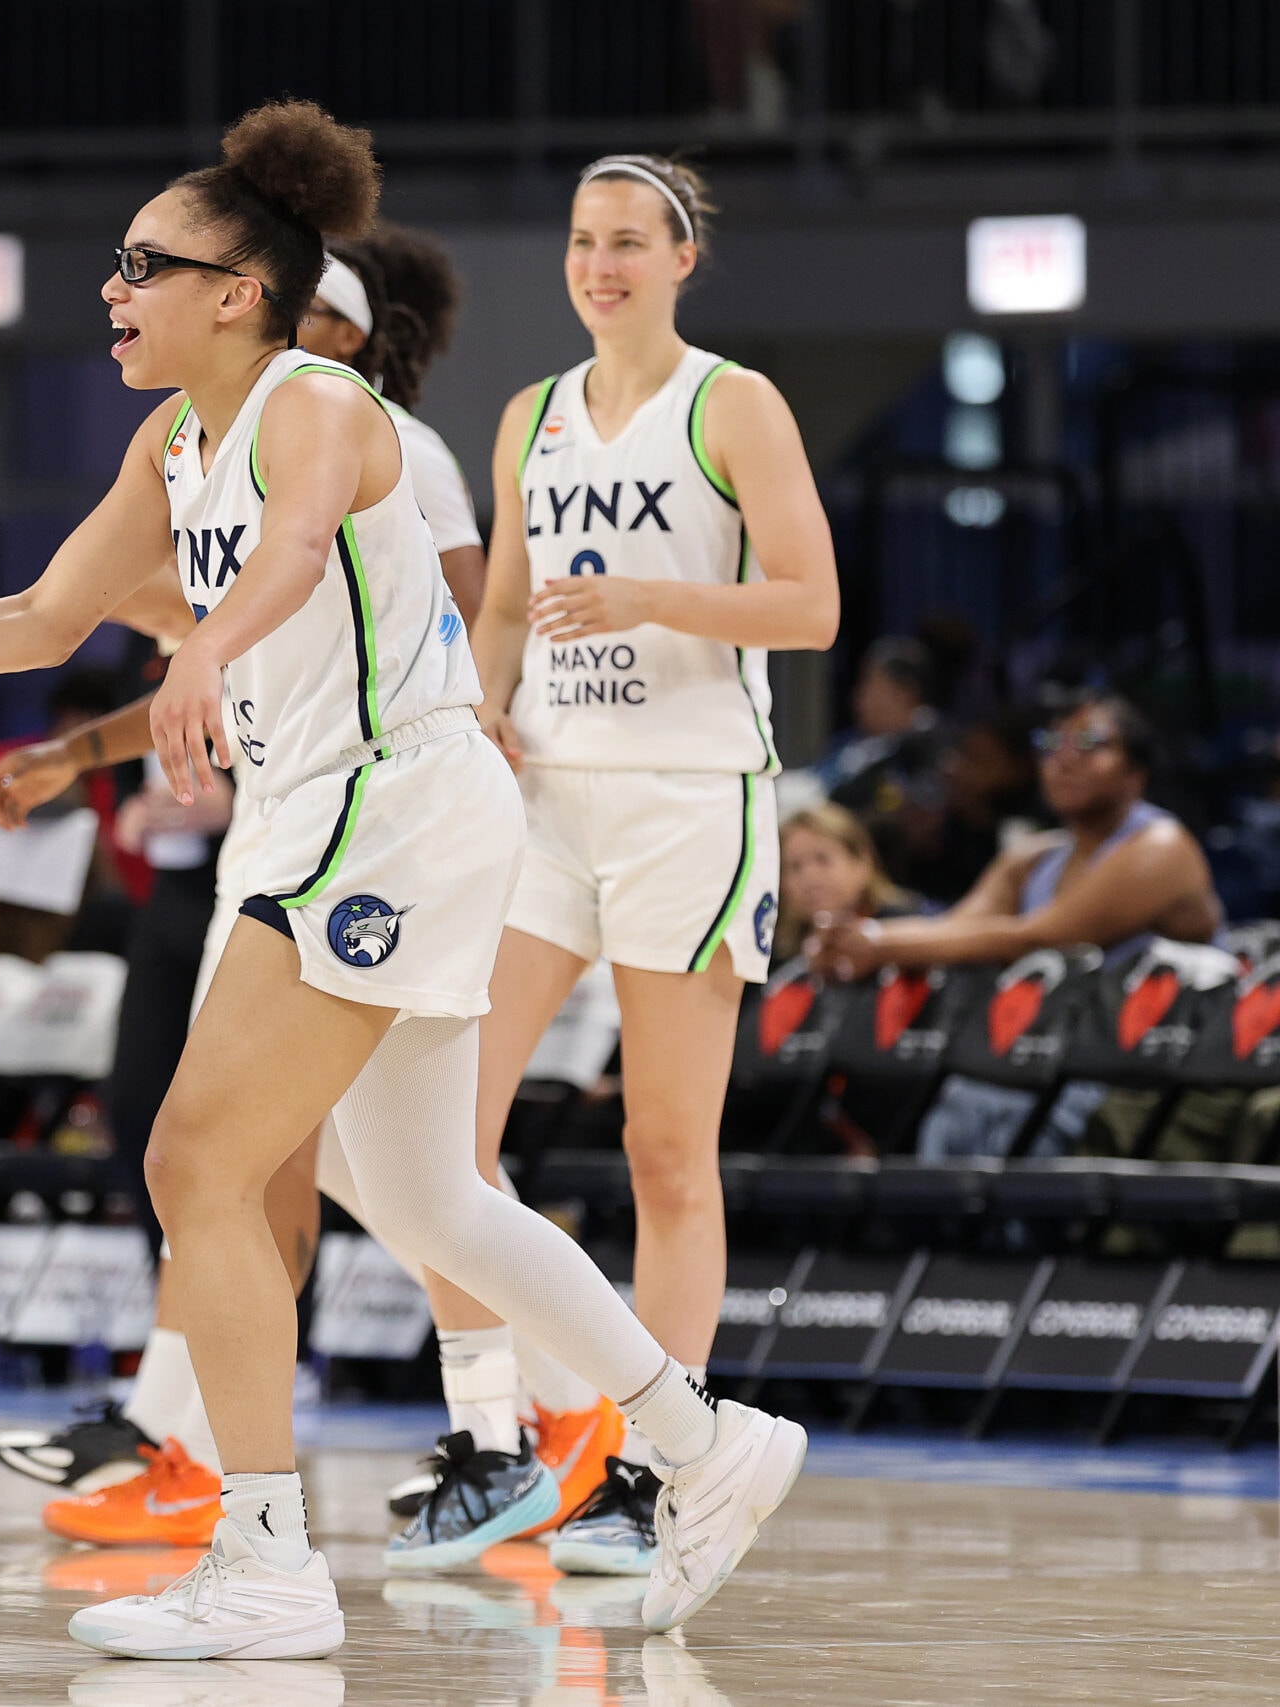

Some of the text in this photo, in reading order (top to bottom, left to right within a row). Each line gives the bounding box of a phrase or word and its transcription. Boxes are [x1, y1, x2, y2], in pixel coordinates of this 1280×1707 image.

[527, 481, 673, 538] LYNX
[173, 525, 247, 590] NX
[551, 644, 635, 673] MAYO
